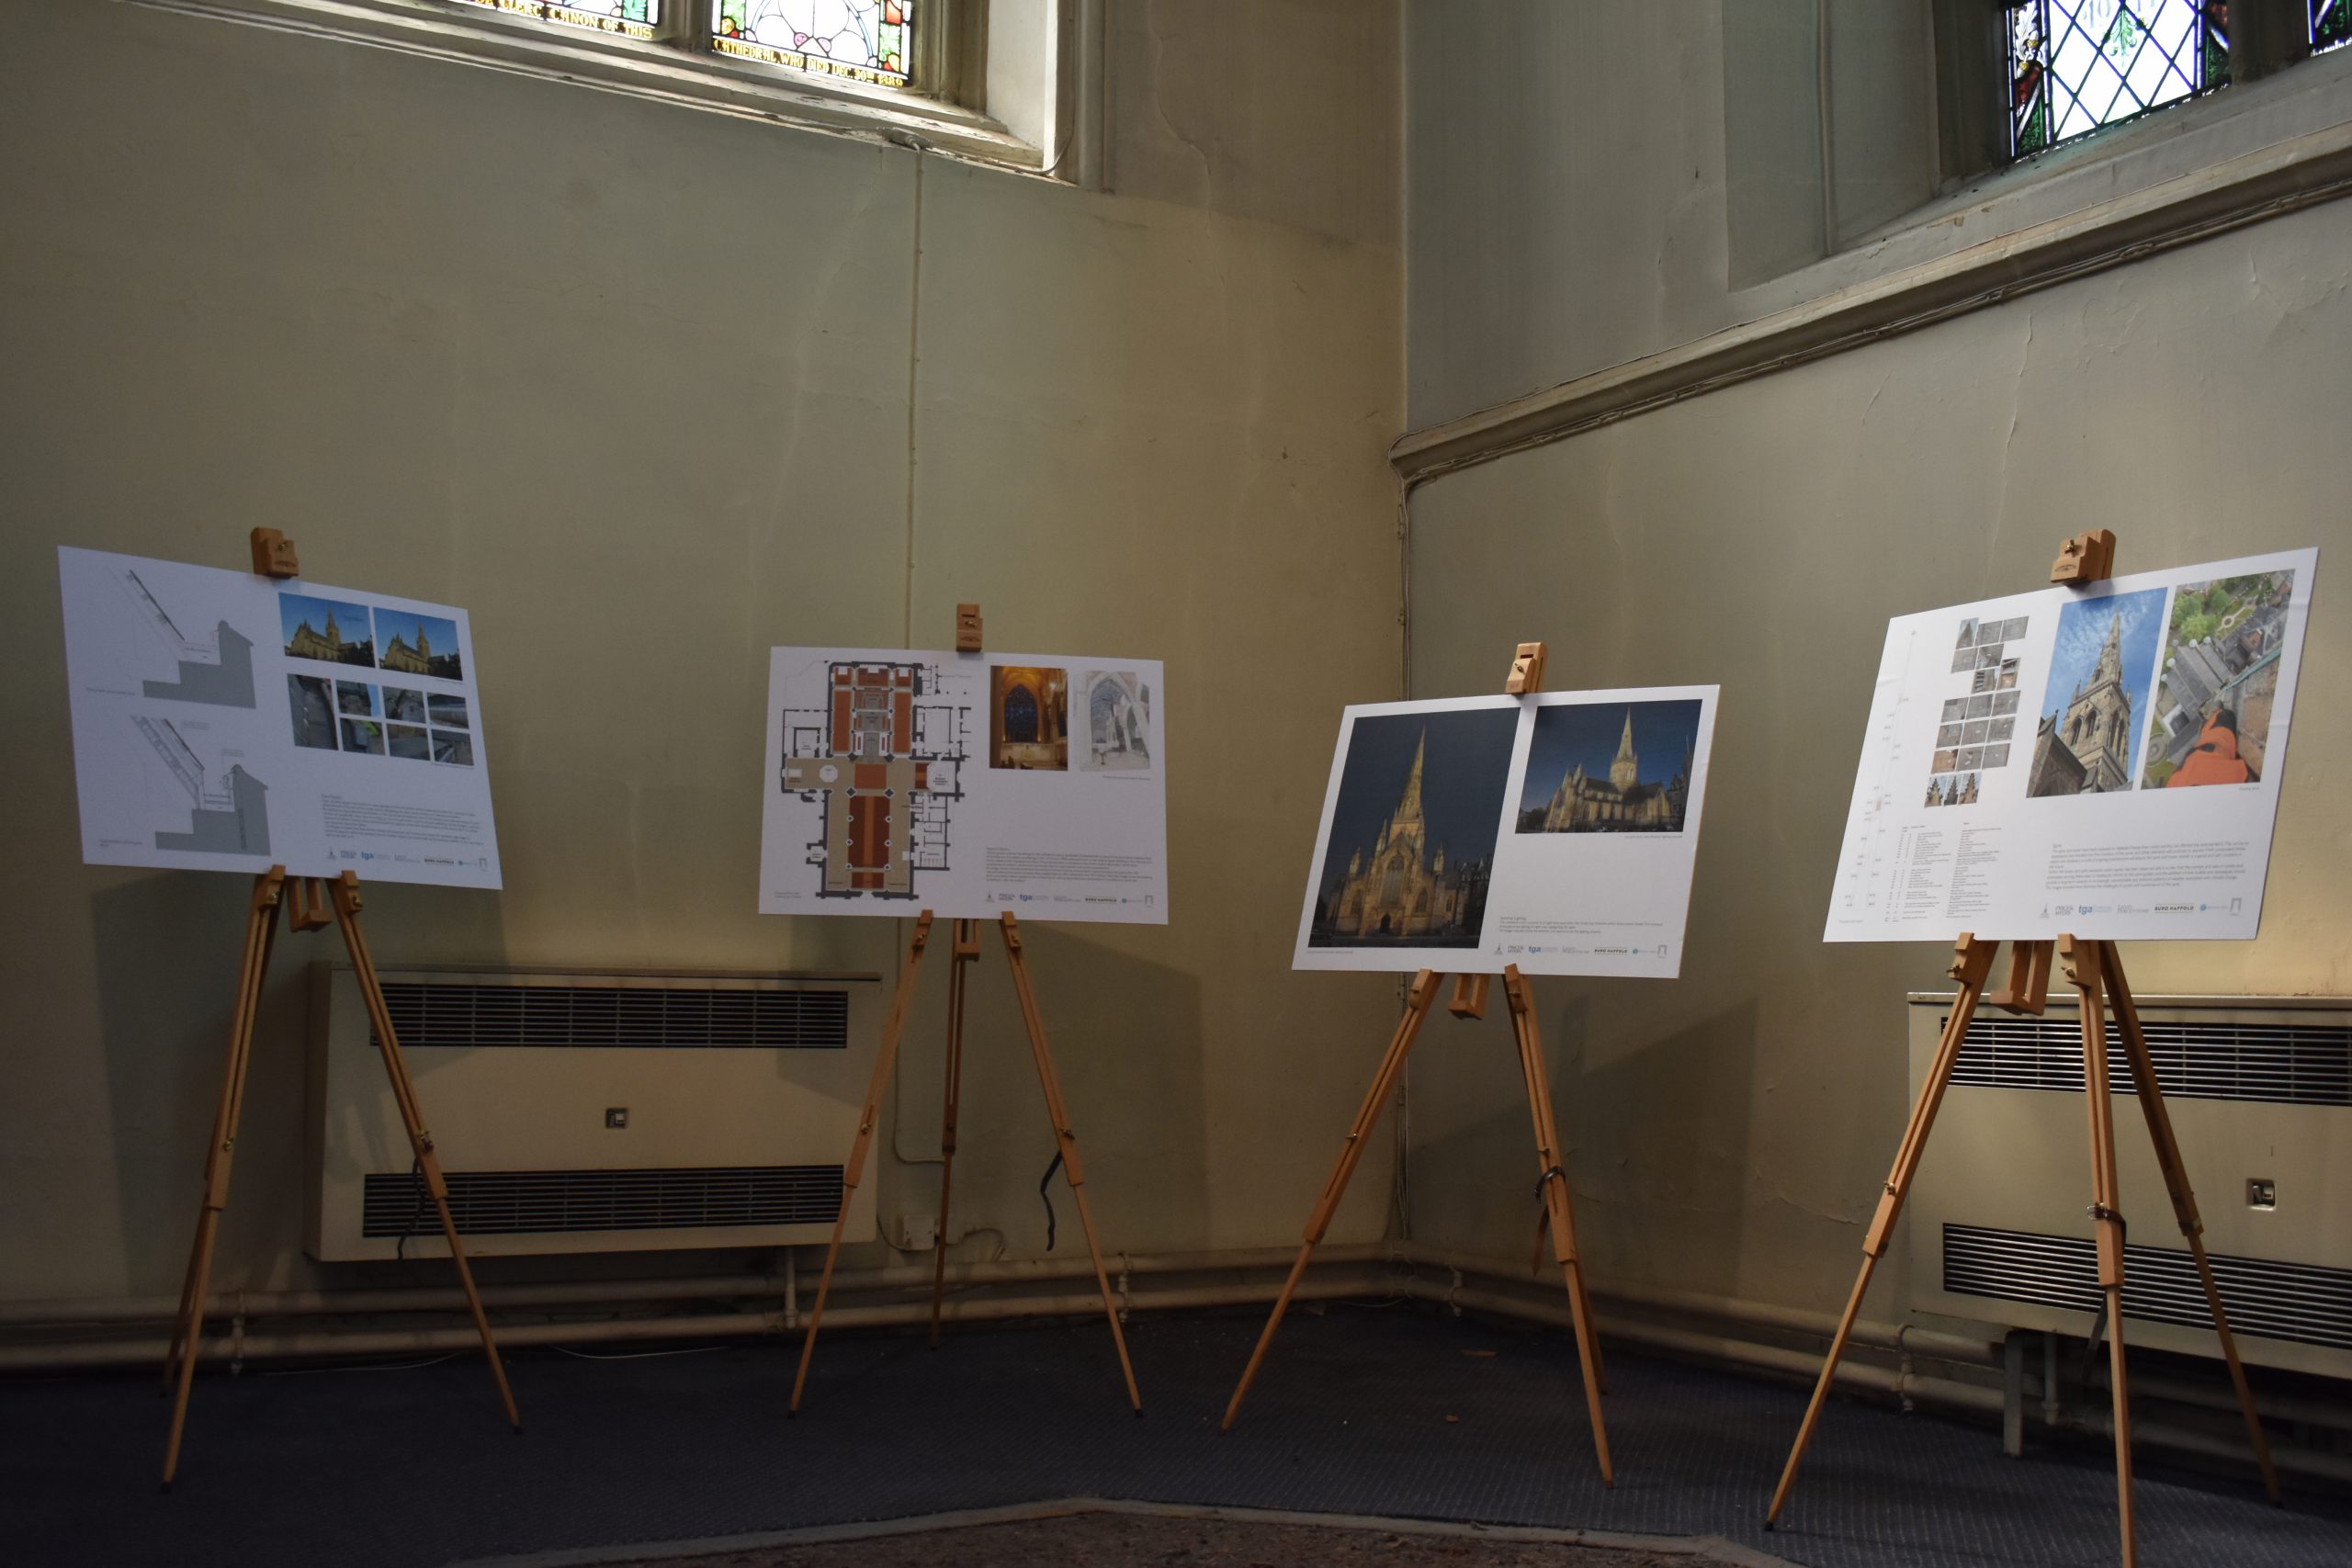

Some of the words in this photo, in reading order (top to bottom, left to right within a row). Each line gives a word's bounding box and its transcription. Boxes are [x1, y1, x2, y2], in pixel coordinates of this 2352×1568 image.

[550, 7, 598, 28] CANON
[603, 19, 618, 32] OF
[624, 23, 652, 39] THIS
[780, 52, 804, 68] WHO
[807, 58, 830, 74] DIED
[1020, 893, 1033, 902] tga
[2078, 905, 2093, 915] tga
